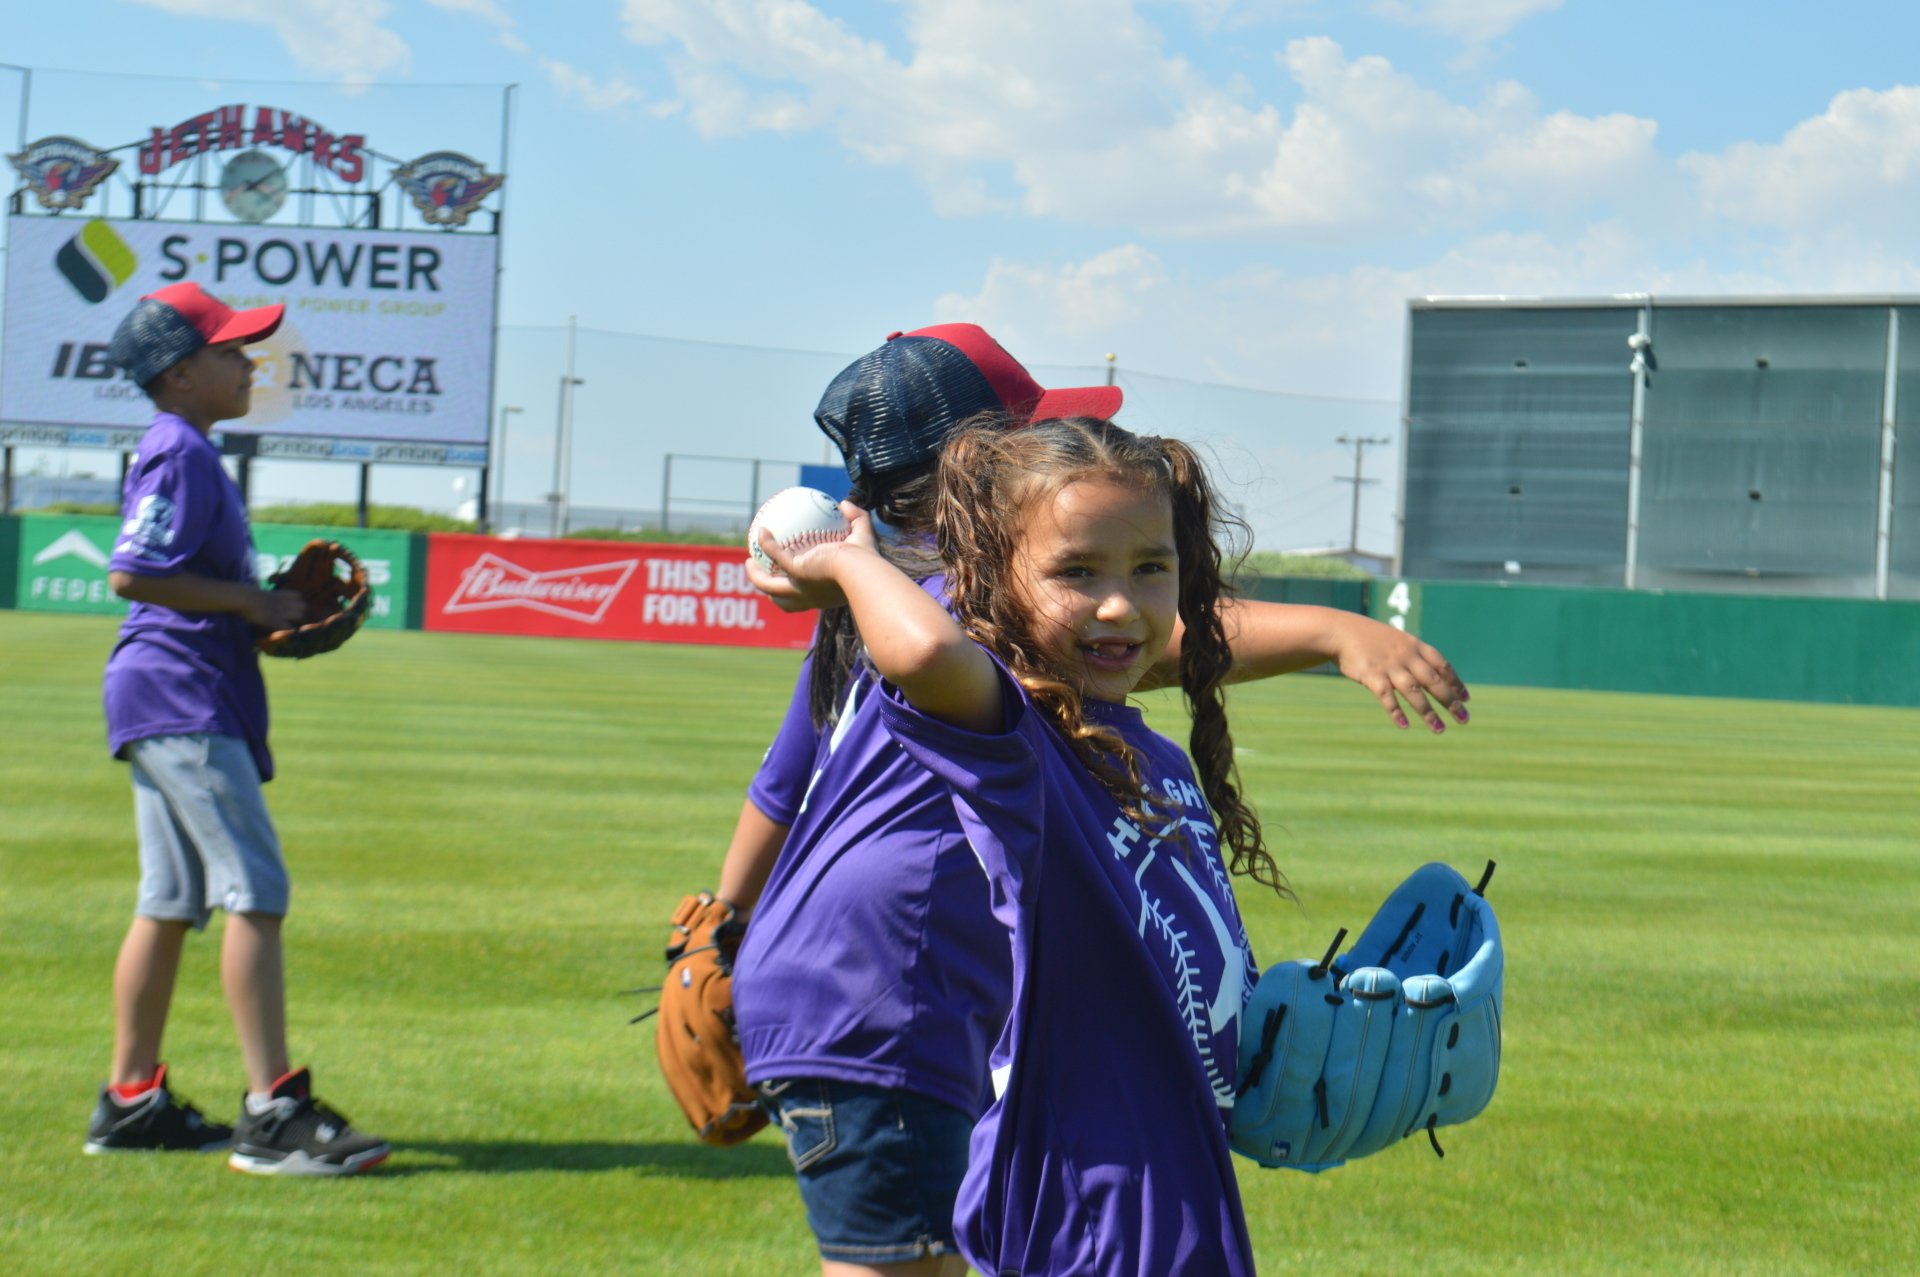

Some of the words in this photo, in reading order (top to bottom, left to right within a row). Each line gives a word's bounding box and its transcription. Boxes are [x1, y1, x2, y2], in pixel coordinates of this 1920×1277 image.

[138, 103, 366, 184] JETHAWKS
[288, 352, 443, 395] NECA
[293, 394, 335, 411] LOS
[341, 397, 436, 415] ANGELES
[30, 575, 119, 604] FEDE
[460, 567, 617, 602] Budweiser
[643, 558, 711, 594] THIS
[643, 592, 698, 627] FOR
[702, 595, 766, 630] YOU.
